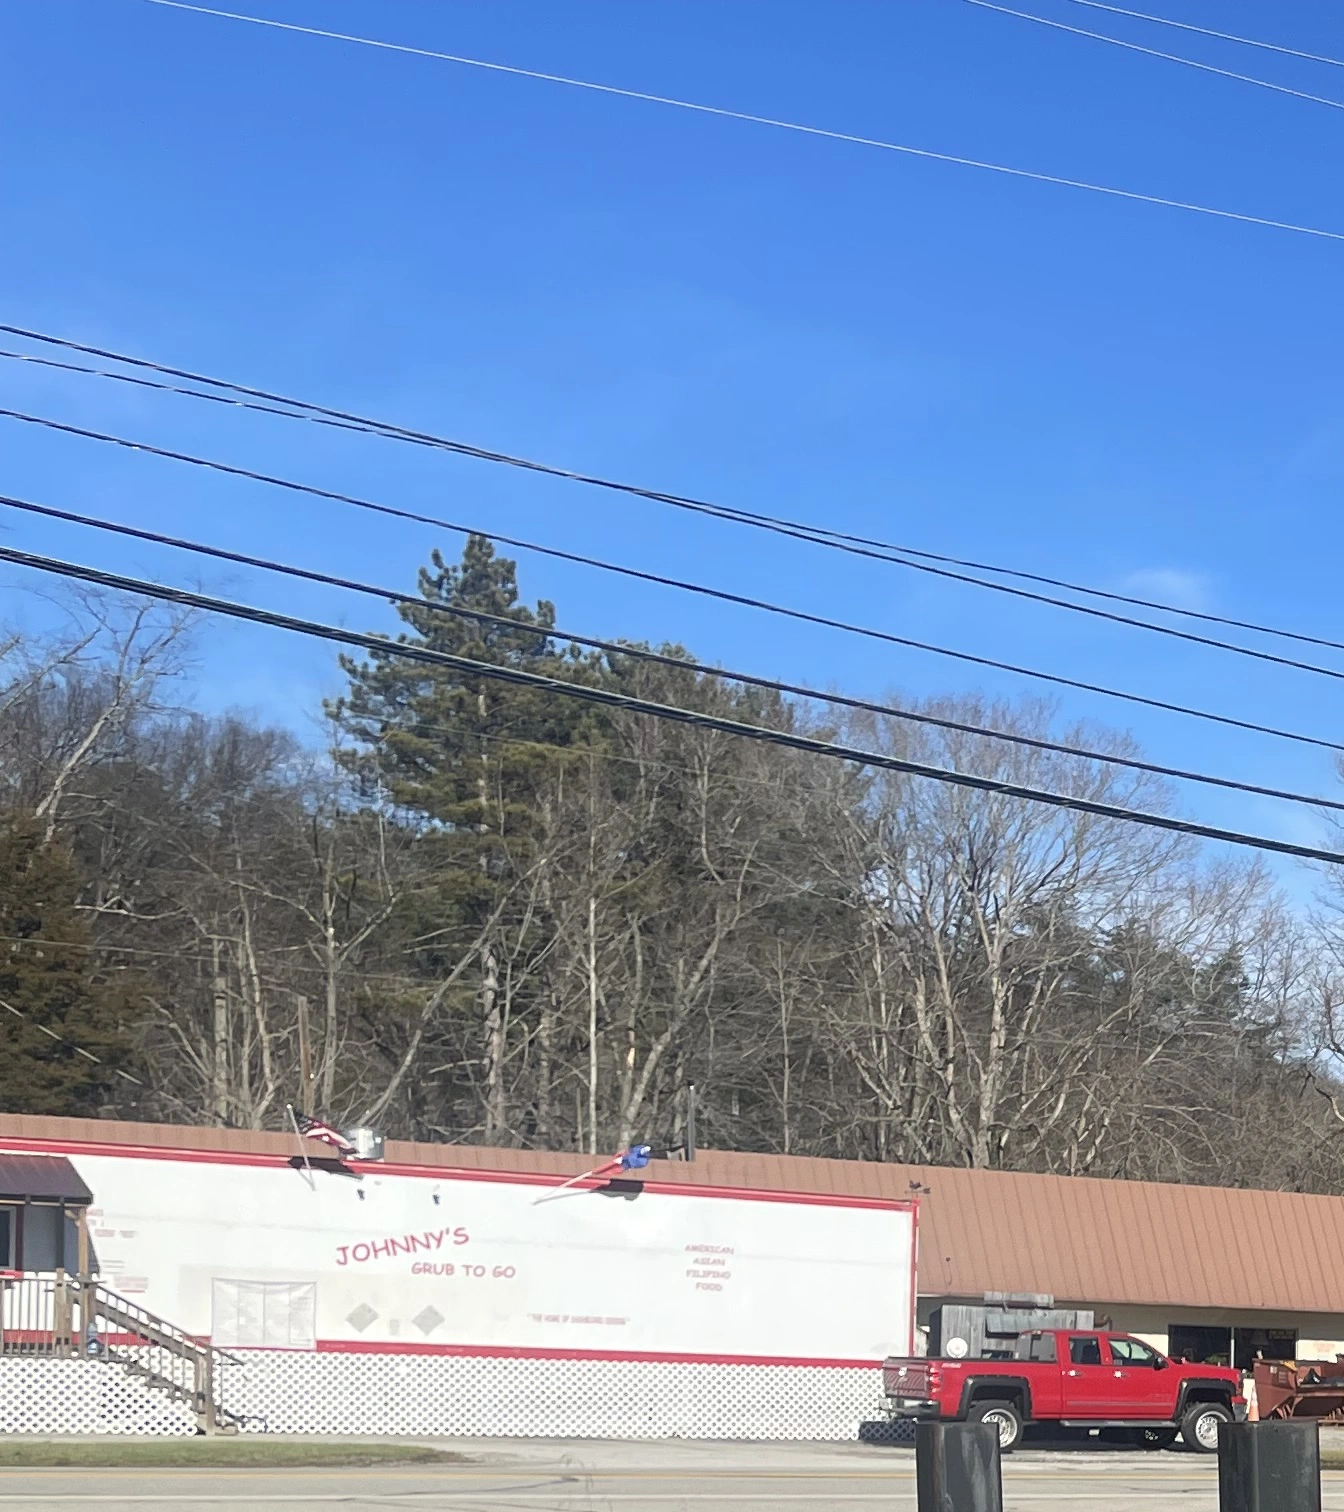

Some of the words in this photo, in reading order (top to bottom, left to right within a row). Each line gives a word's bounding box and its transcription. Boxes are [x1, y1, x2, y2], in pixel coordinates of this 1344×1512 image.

[336, 1227, 469, 1266] JOHNNY'S
[685, 1244, 734, 1255] AMERICAN
[411, 1262, 454, 1276] GRUB
[461, 1264, 486, 1277] TO
[492, 1265, 516, 1278] GO
